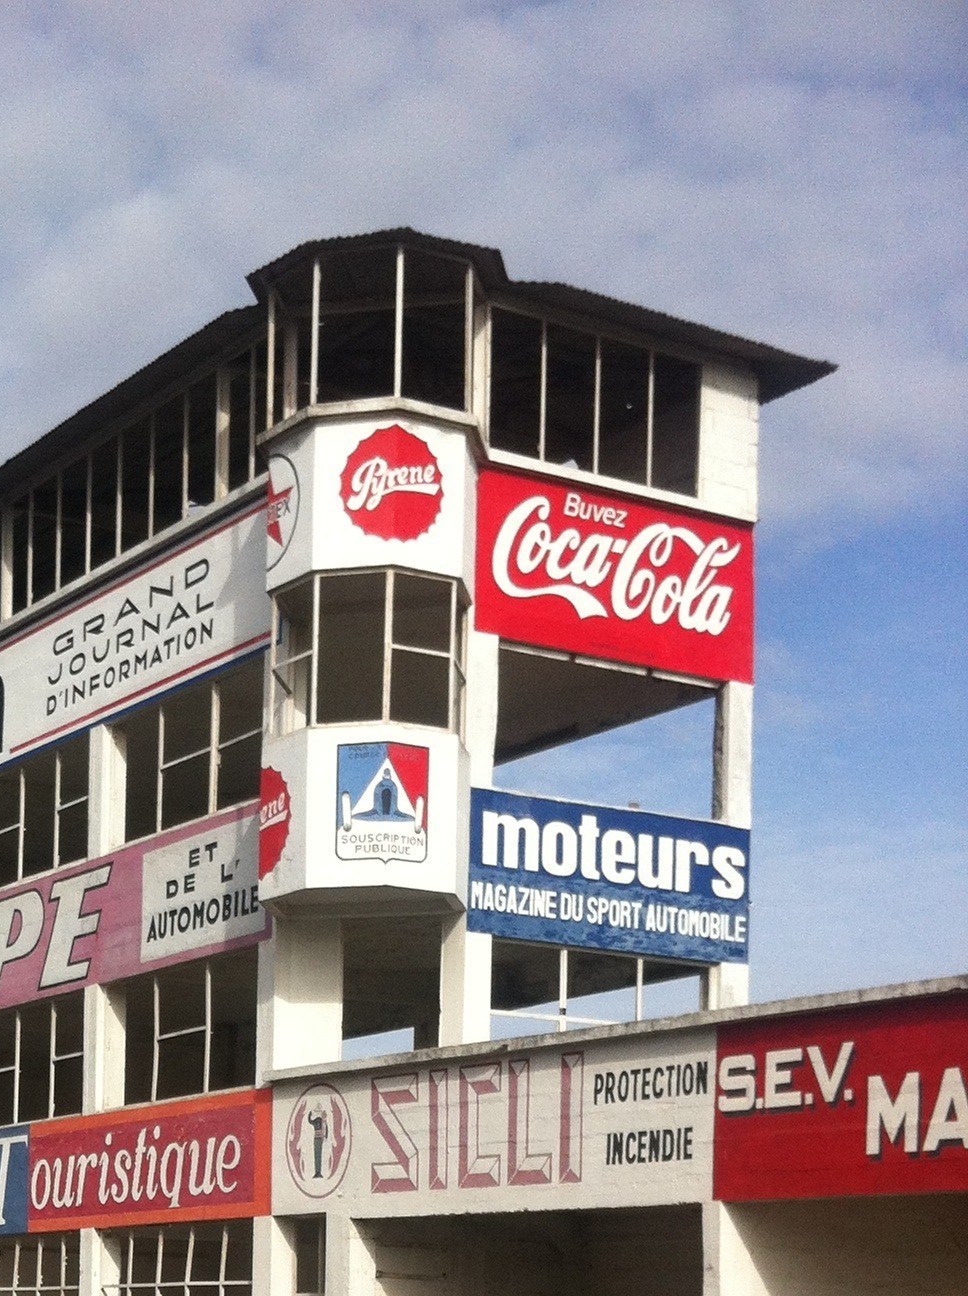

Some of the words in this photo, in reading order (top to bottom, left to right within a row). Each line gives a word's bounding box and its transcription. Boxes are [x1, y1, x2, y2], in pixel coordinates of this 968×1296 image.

[348, 457, 440, 511] Pyrene
[563, 491, 628, 529] Buvez
[492, 496, 742, 637] Coca-Cola
[52, 557, 212, 657] GRAND
[47, 592, 215, 686] JOURNAL
[46, 618, 215, 718] D'INFORMATION
[189, 842, 218, 870] ET
[341, 833, 424, 847] SOUSCRIPTION
[355, 844, 411, 856] PUBLIQUE
[481, 810, 747, 900] moteurs
[166, 871, 197, 899] DE
[470, 881, 558, 921] MAGAZINE
[560, 896, 585, 923] DU
[586, 898, 643, 931] SPORT
[644, 905, 747, 944] AUTOMOBILE
[146, 884, 260, 944] AUTOMOBILE
[592, 1061, 710, 1106] PROTECTION
[370, 1049, 586, 1195] SICLI
[604, 1126, 695, 1167] INCENDIE
